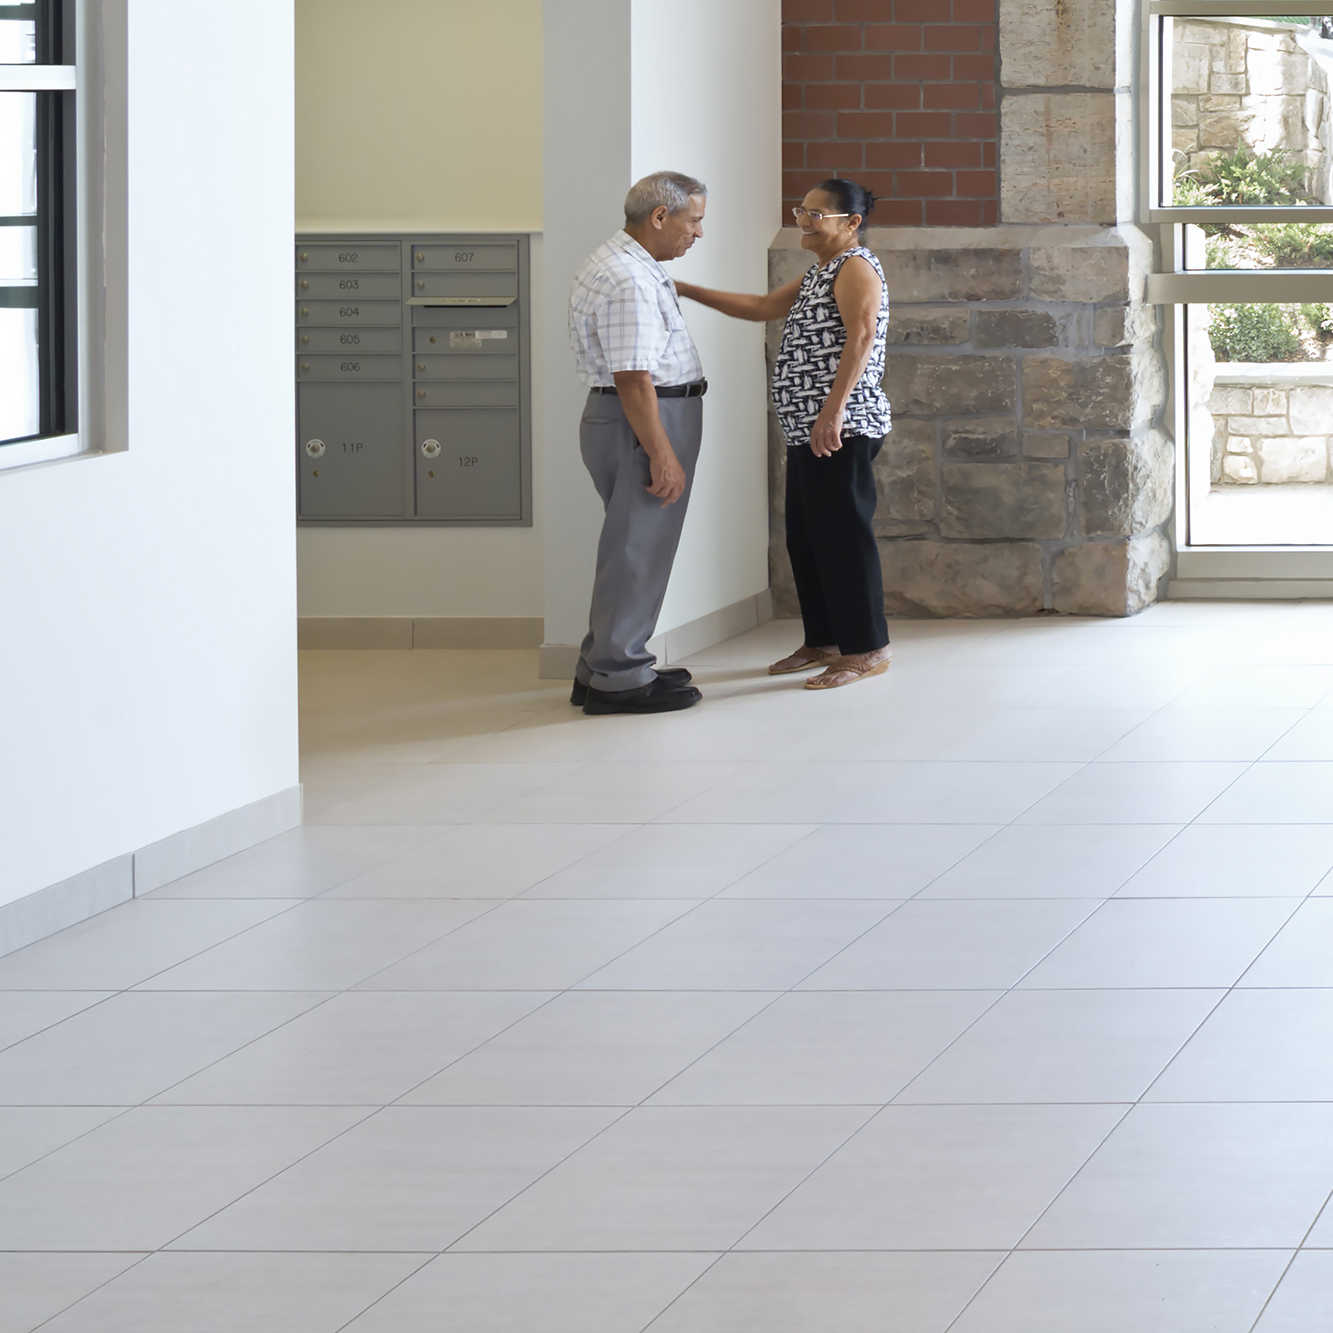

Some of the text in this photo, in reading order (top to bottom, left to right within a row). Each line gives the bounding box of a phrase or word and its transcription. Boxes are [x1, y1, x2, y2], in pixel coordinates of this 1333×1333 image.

[338, 252, 358, 263] 602
[454, 252, 475, 263] 607
[339, 279, 360, 290] 603
[339, 307, 360, 318] 604
[339, 334, 360, 345] 605
[340, 361, 361, 372] 606
[342, 442, 364, 453] 11P
[459, 456, 479, 467] 12P
